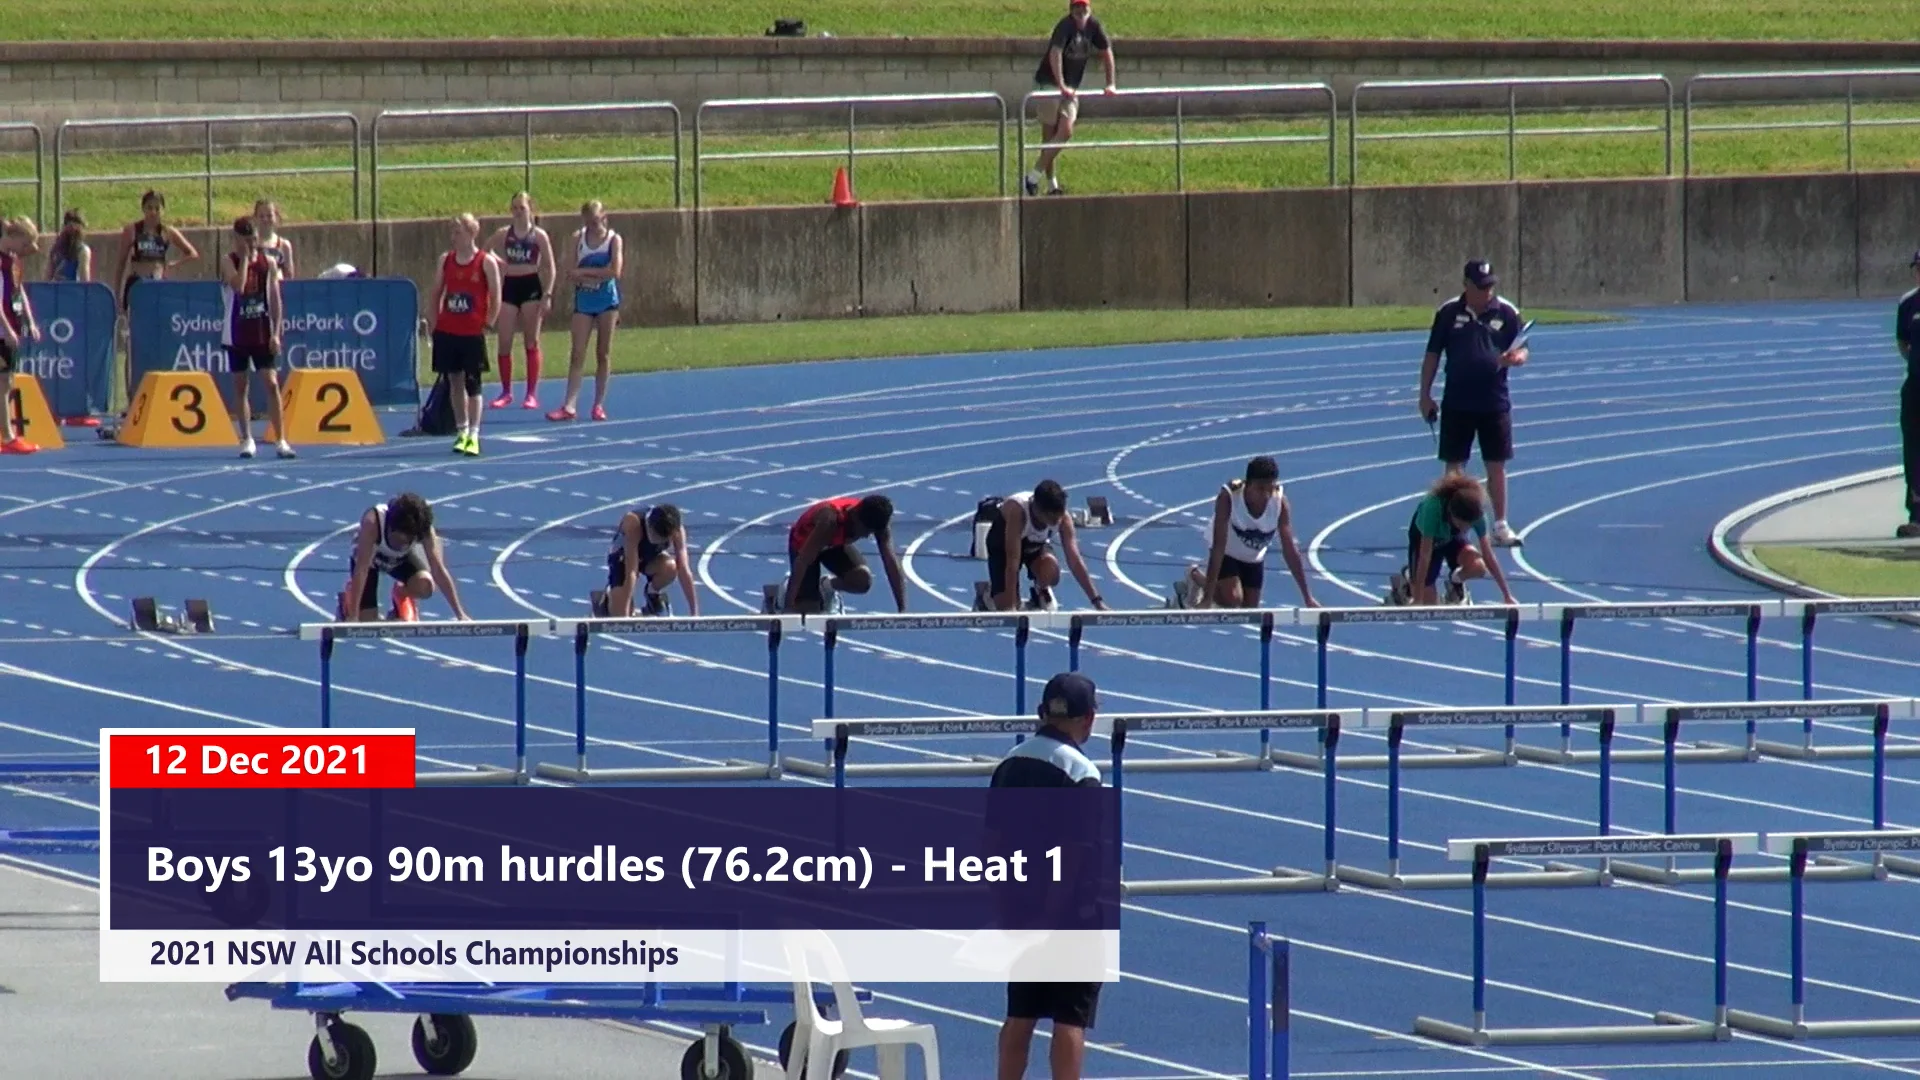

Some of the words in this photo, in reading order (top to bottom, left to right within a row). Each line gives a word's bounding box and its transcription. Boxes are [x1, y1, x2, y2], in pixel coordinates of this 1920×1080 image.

[171, 313, 223, 336] Sydne
[16, 347, 74, 379] ntre
[287, 342, 377, 372] Centre
[170, 384, 206, 434] 3
[316, 382, 352, 432] 2
[851, 619, 882, 630] Sydney
[884, 619, 918, 629] Olympic
[921, 618, 940, 627] Park
[942, 617, 973, 627] Athletic
[975, 617, 1004, 626] Centre
[1096, 615, 1127, 625] Sydney
[1129, 615, 1164, 625] Olympic
[1166, 614, 1186, 623] Park
[1188, 614, 1219, 623] Athletic
[1220, 613, 1249, 623] Centre
[602, 623, 633, 632] Sydney
[635, 622, 671, 632] Olympic
[673, 622, 692, 631] Park
[694, 621, 726, 630] Athletic
[727, 621, 757, 629] Centre
[1419, 713, 1451, 724] Sydney
[1454, 713, 1492, 723] Olympic
[1496, 712, 1517, 722] Park
[1519, 712, 1553, 721] Athletic
[1555, 711, 1588, 721] Centre
[1693, 708, 1727, 719] Sydney
[1729, 708, 1768, 718] Olympic
[1770, 707, 1791, 717] Park
[1794, 706, 1828, 716] Athletic
[1829, 705, 1861, 715] Centre
[863, 724, 898, 735] Sydney
[900, 723, 941, 735] Olympic
[943, 722, 964, 732] Park
[966, 721, 1001, 732] Athletic
[1004, 721, 1036, 731] Centre
[1141, 719, 1174, 729] Sydney
[1178, 718, 1216, 729] Olympic
[1219, 718, 1241, 727] Park
[1243, 717, 1278, 726] Athletic
[1280, 716, 1312, 726] Centre
[1505, 843, 1545, 854] Sydney
[1548, 842, 1593, 854] Olympic
[1596, 841, 1619, 851] Park
[1621, 840, 1660, 850] Athletic
[1663, 840, 1700, 850] Centre
